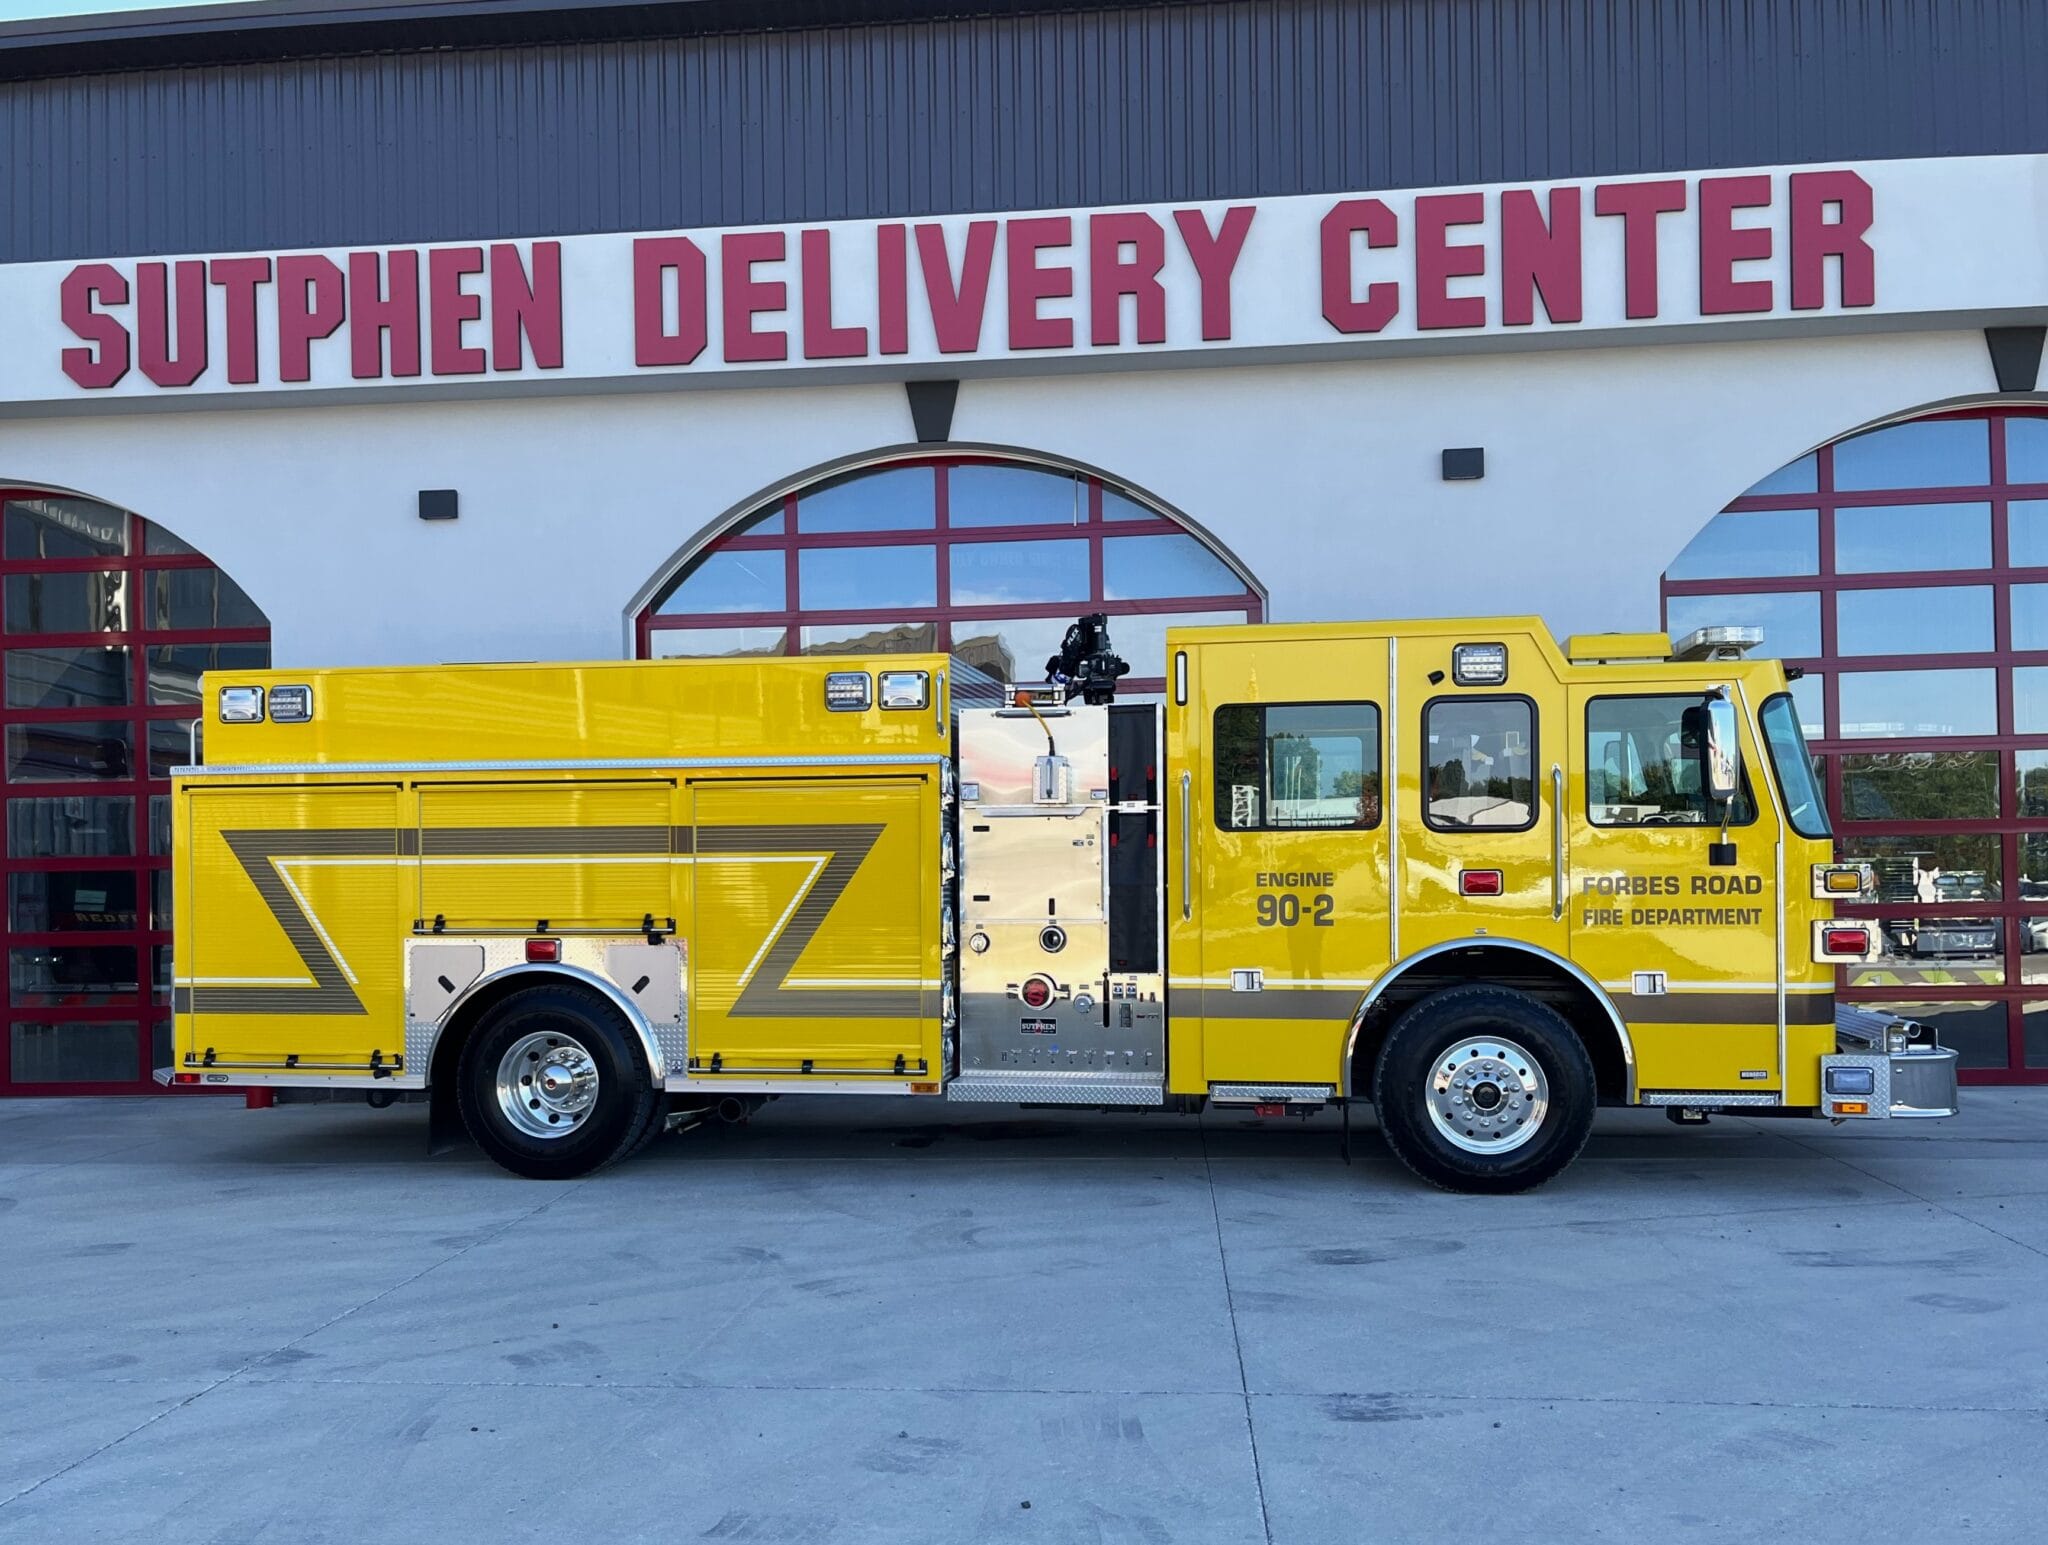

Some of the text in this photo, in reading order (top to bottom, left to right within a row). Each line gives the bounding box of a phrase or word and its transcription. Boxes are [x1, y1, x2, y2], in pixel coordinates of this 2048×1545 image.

[60, 169, 1876, 389] SUTPHEN DELIVERY CENTER
[1256, 872, 1334, 888] ENGINE
[1582, 875, 1763, 896] FORBES ROAD
[1256, 893, 1335, 927] 90-2
[1582, 908, 1763, 926] FIRE DEPARTMENT
